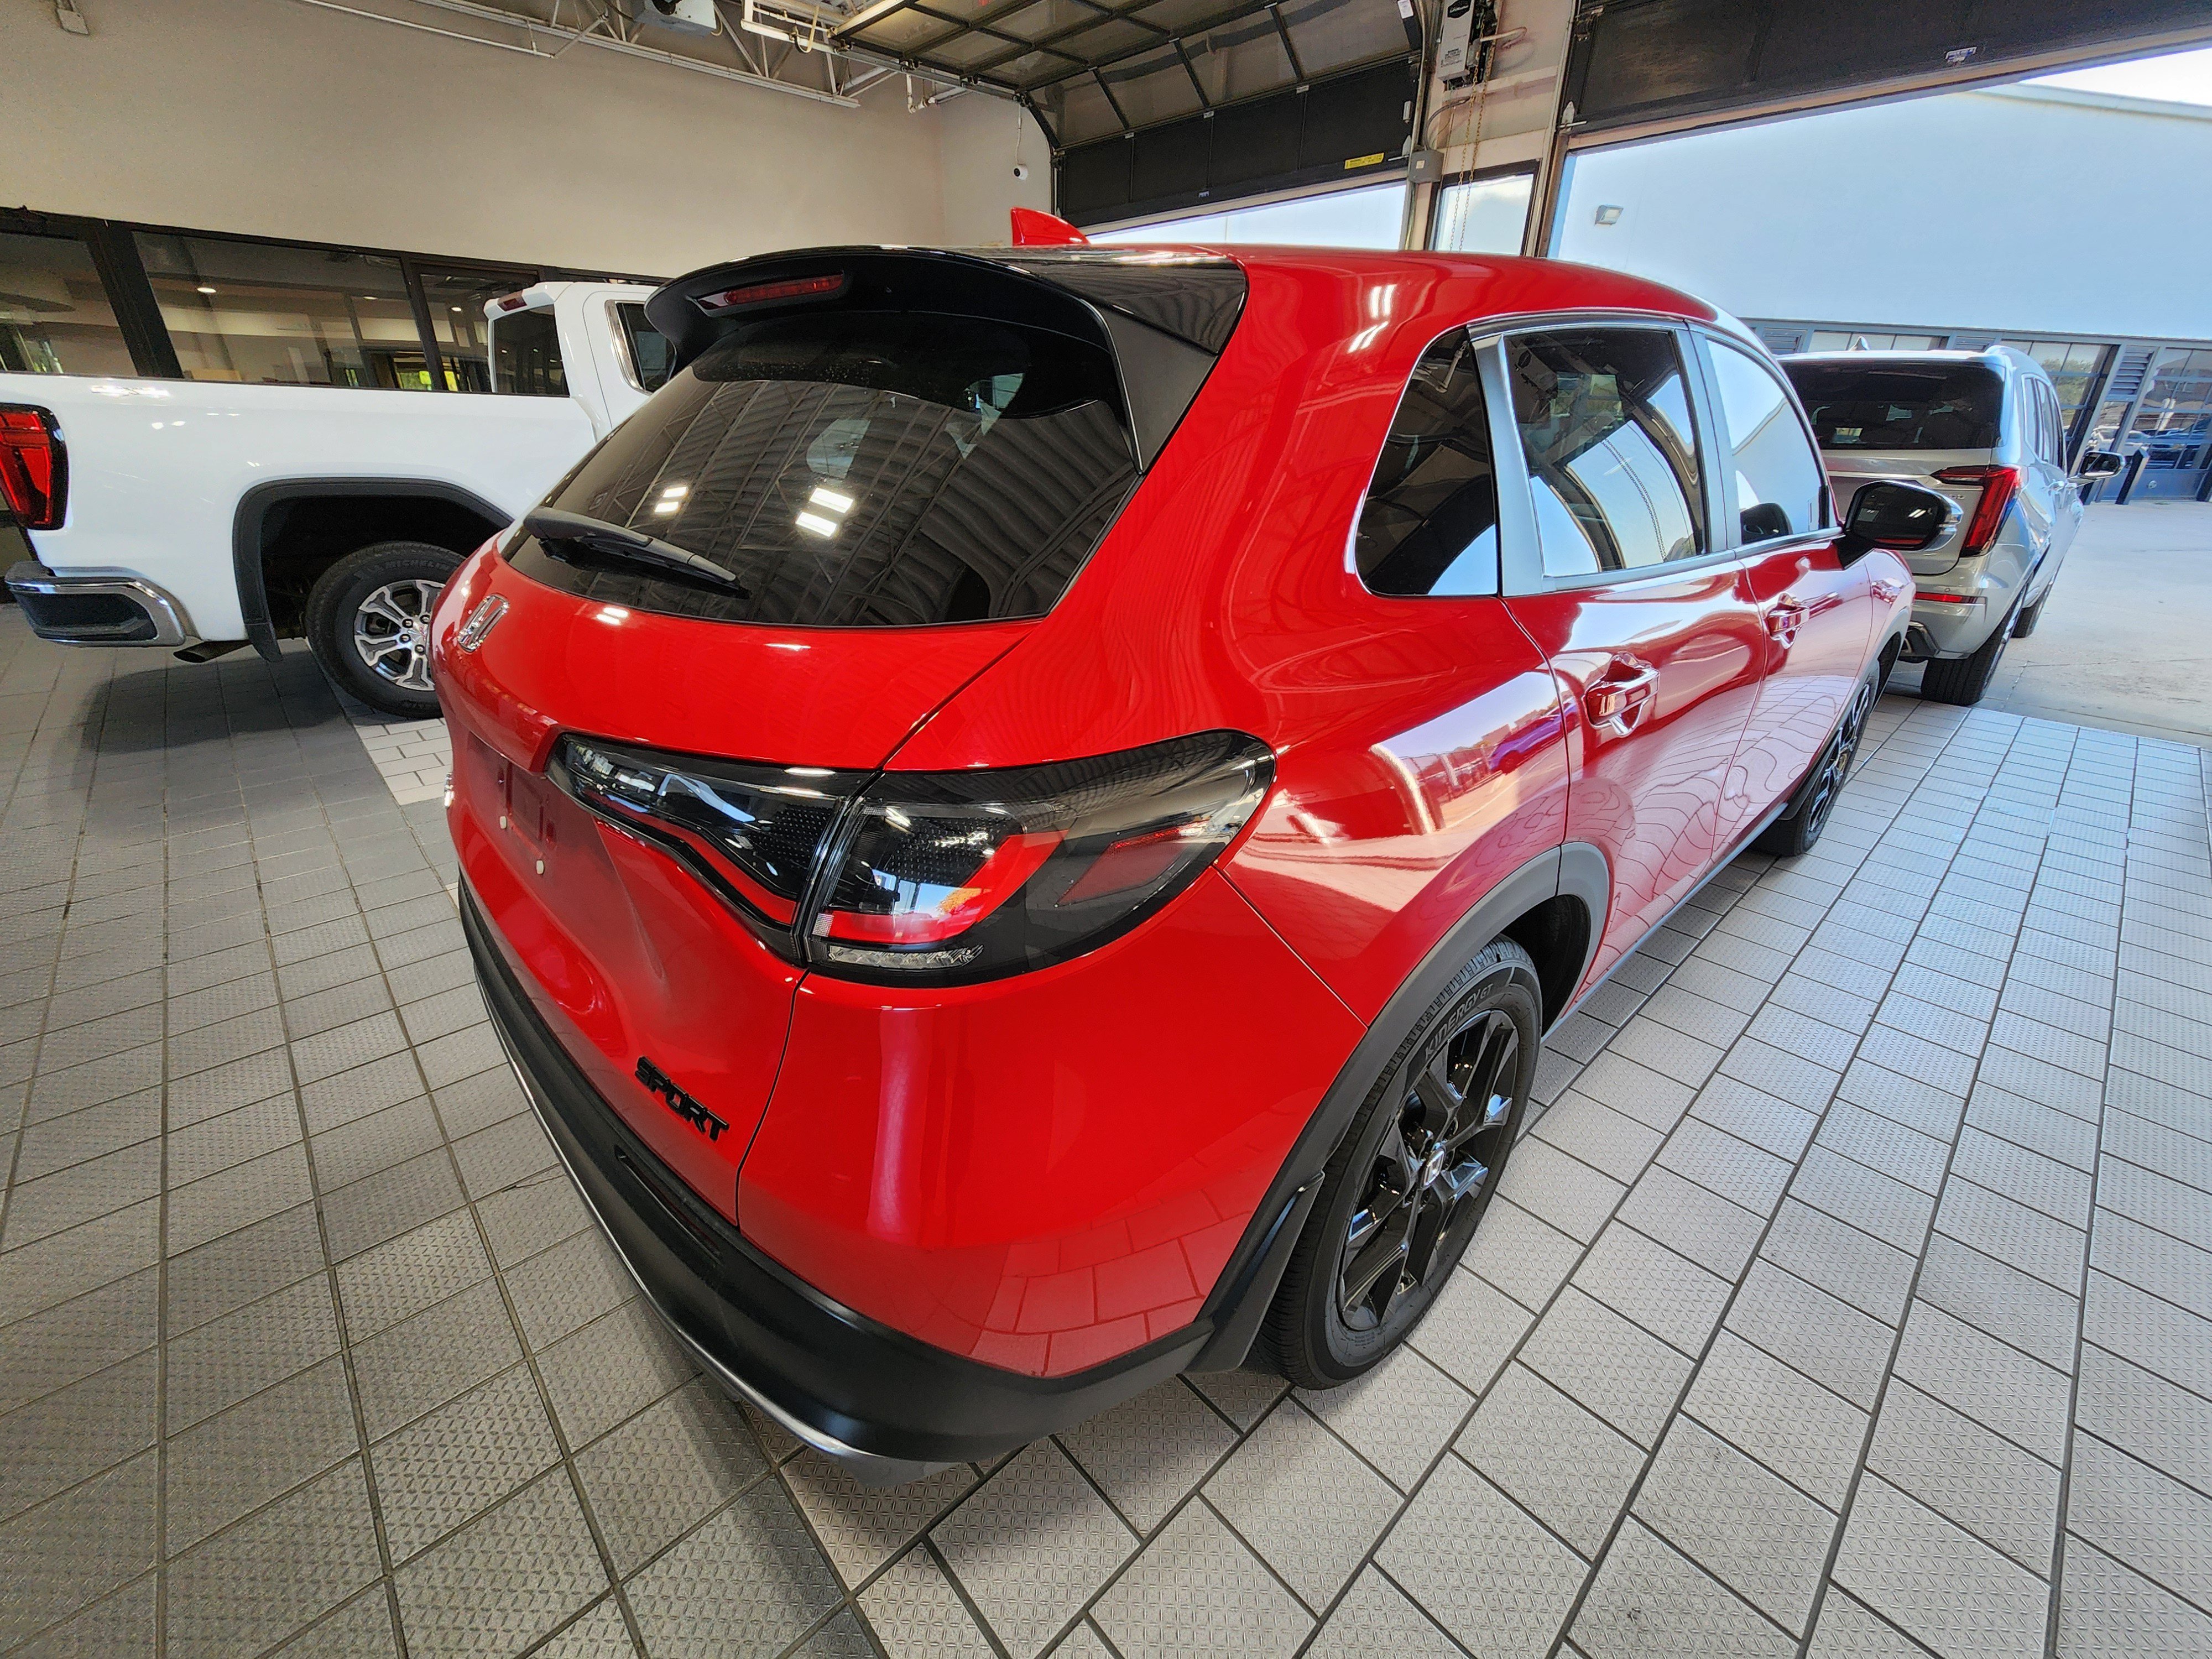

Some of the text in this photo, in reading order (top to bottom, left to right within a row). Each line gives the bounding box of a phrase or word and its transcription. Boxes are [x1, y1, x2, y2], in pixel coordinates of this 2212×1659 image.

[1425, 983, 1494, 1061] KINERGY GT
[634, 1056, 730, 1141] SPORT
